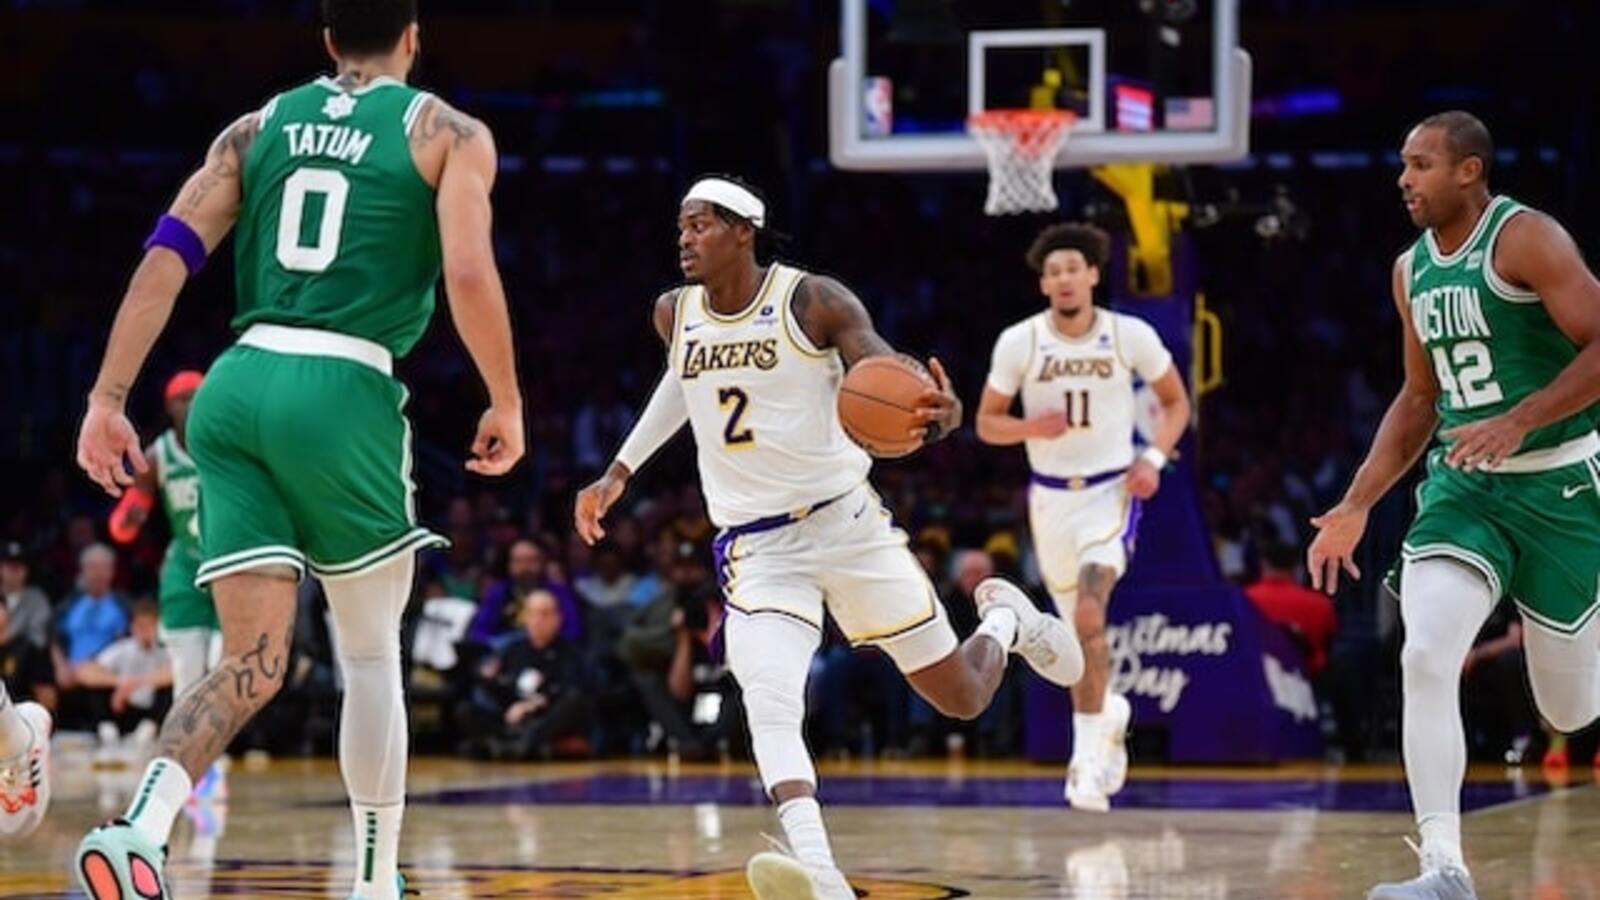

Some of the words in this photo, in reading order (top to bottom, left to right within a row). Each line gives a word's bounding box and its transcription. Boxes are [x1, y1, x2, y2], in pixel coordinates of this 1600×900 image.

[282, 122, 373, 165] TATUM
[275, 166, 350, 272] 0
[682, 338, 779, 379] LAKERS
[1037, 354, 1114, 382] LAKERS
[1432, 340, 1504, 410] 42
[717, 386, 757, 450] 2
[1064, 390, 1091, 429] 11
